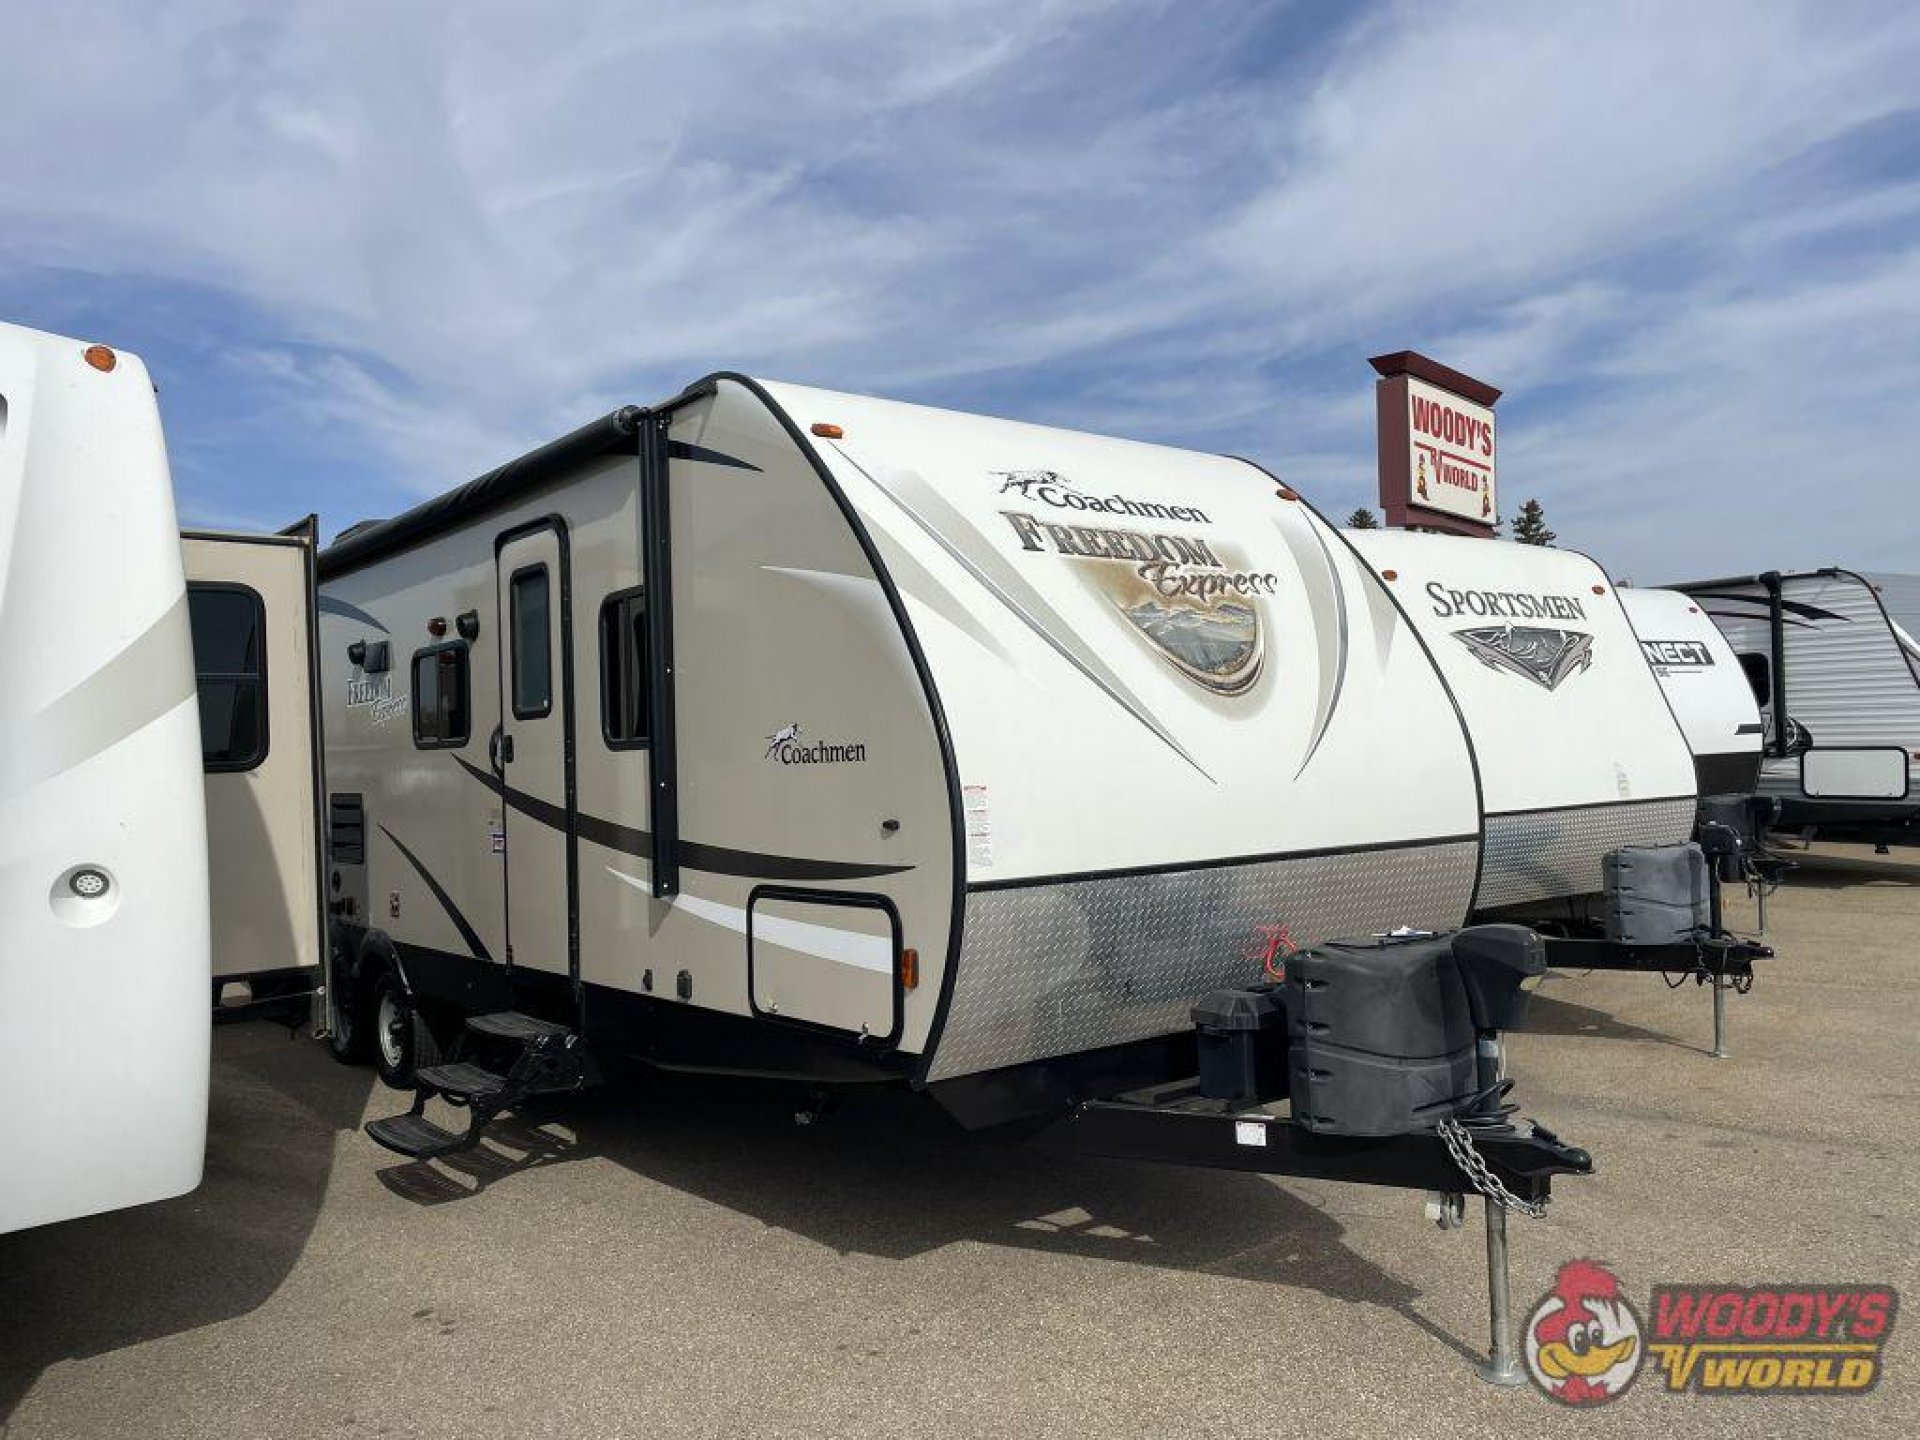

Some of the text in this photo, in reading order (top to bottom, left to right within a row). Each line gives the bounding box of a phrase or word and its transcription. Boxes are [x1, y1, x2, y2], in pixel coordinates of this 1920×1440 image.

[1411, 395, 1492, 457] WOODY'S
[1443, 464, 1478, 491] WORLD
[1037, 485, 1211, 523] Coachmen
[999, 510, 1222, 567] FREEDOM
[1138, 561, 1277, 602] Express
[1426, 581, 1586, 621] SPORTSMEN
[781, 740, 866, 765] Coachmen
